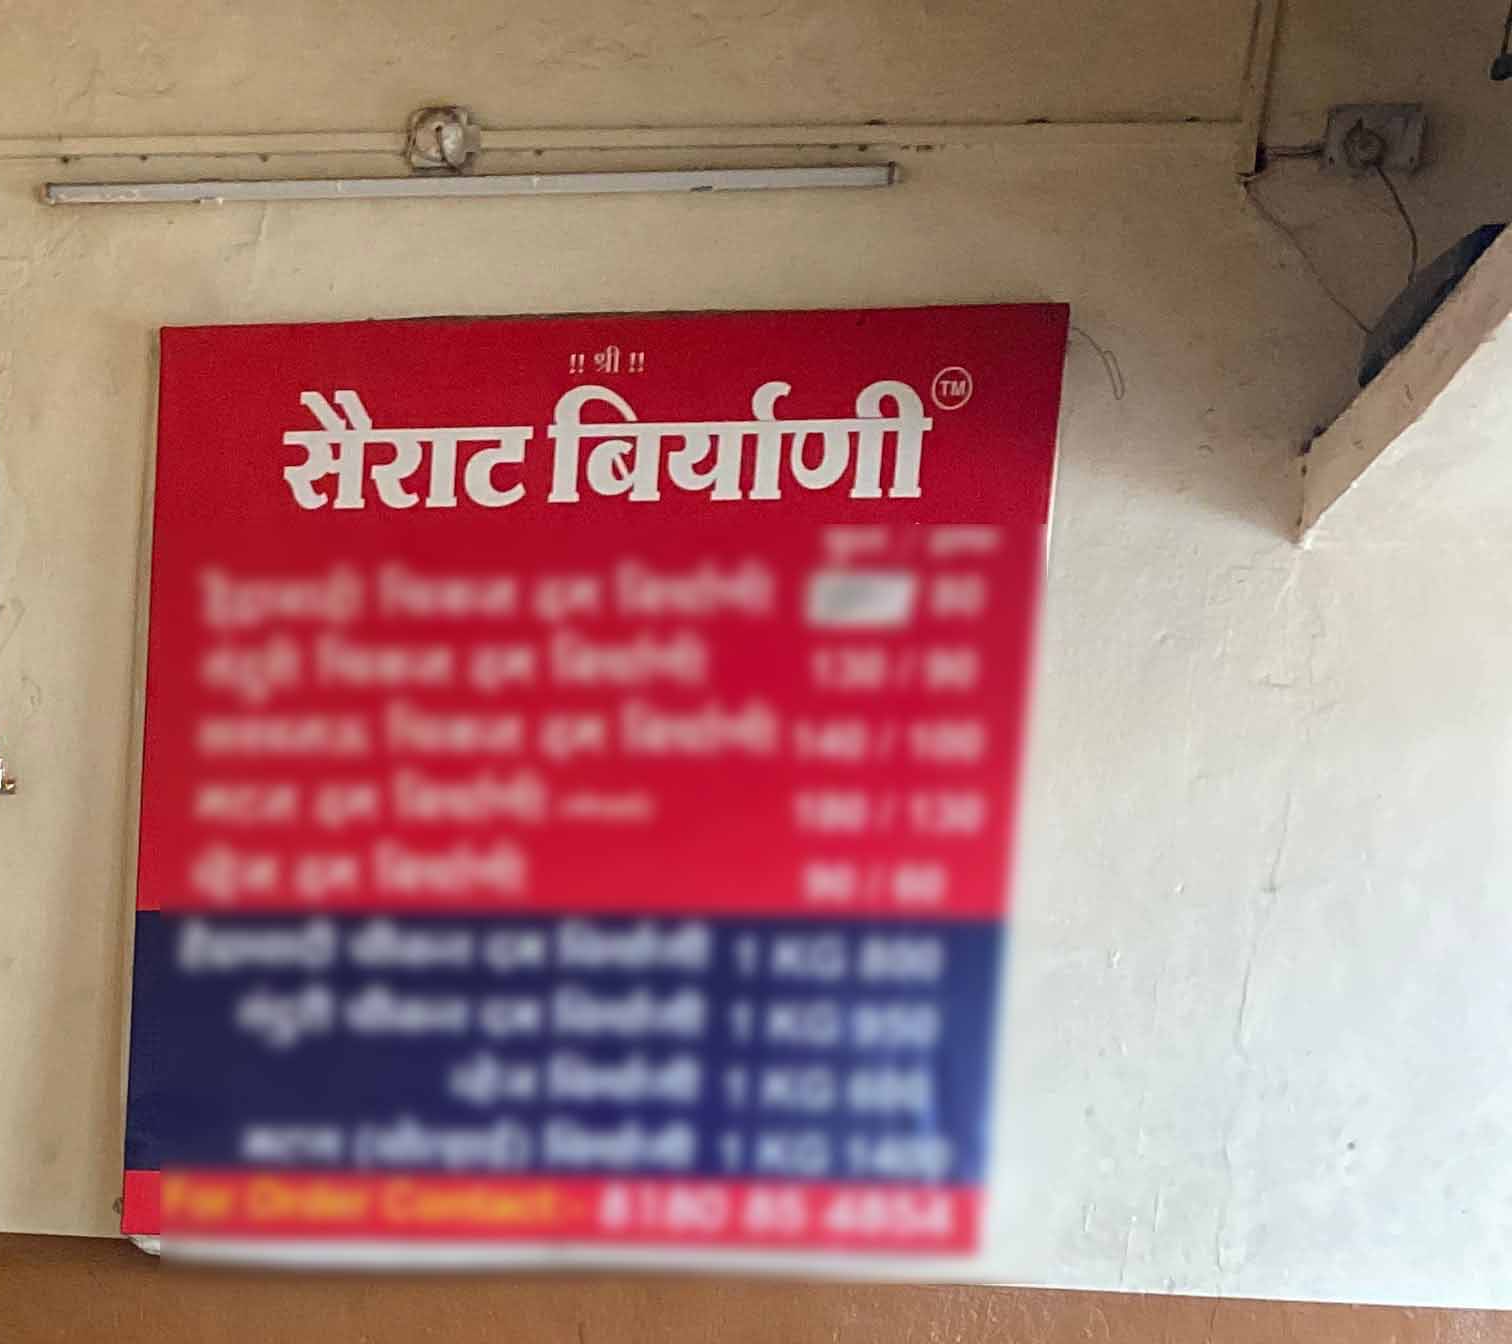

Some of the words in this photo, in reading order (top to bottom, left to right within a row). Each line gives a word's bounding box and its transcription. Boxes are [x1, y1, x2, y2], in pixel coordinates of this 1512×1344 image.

[593, 345, 620, 373] श्री
[282, 389, 534, 510] सैराट
[548, 380, 932, 503] बिर्याणी
[939, 380, 966, 397] TM
